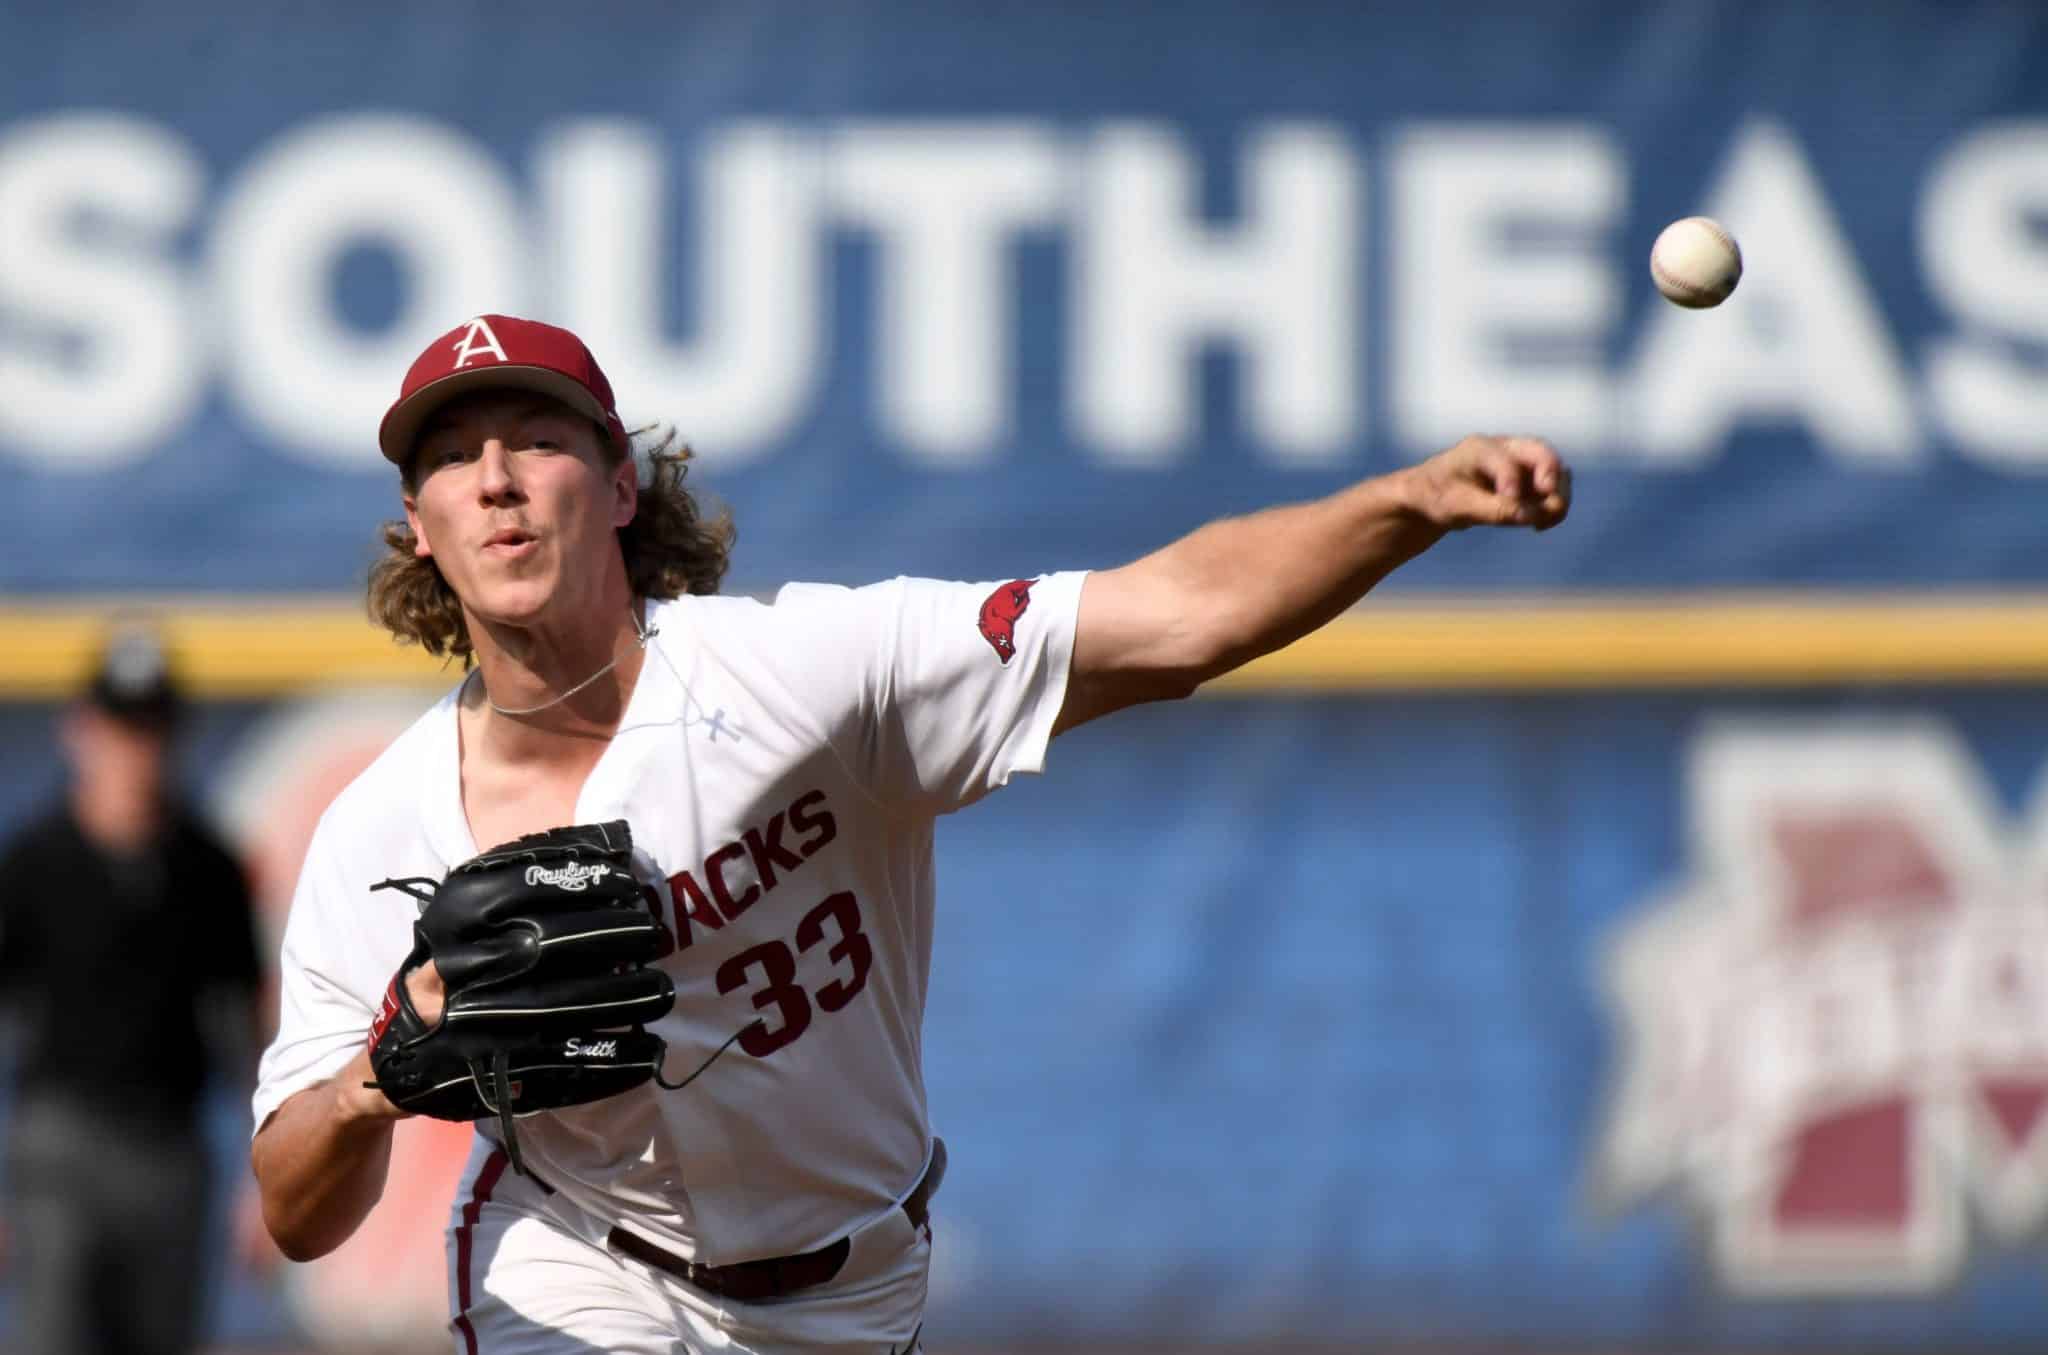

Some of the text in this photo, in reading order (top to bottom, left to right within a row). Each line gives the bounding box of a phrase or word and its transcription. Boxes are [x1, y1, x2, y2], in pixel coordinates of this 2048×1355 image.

[452, 317, 509, 369] A
[525, 861, 611, 891] Rawlings
[715, 890, 873, 1057] 33
[564, 1037, 617, 1059] Smith
